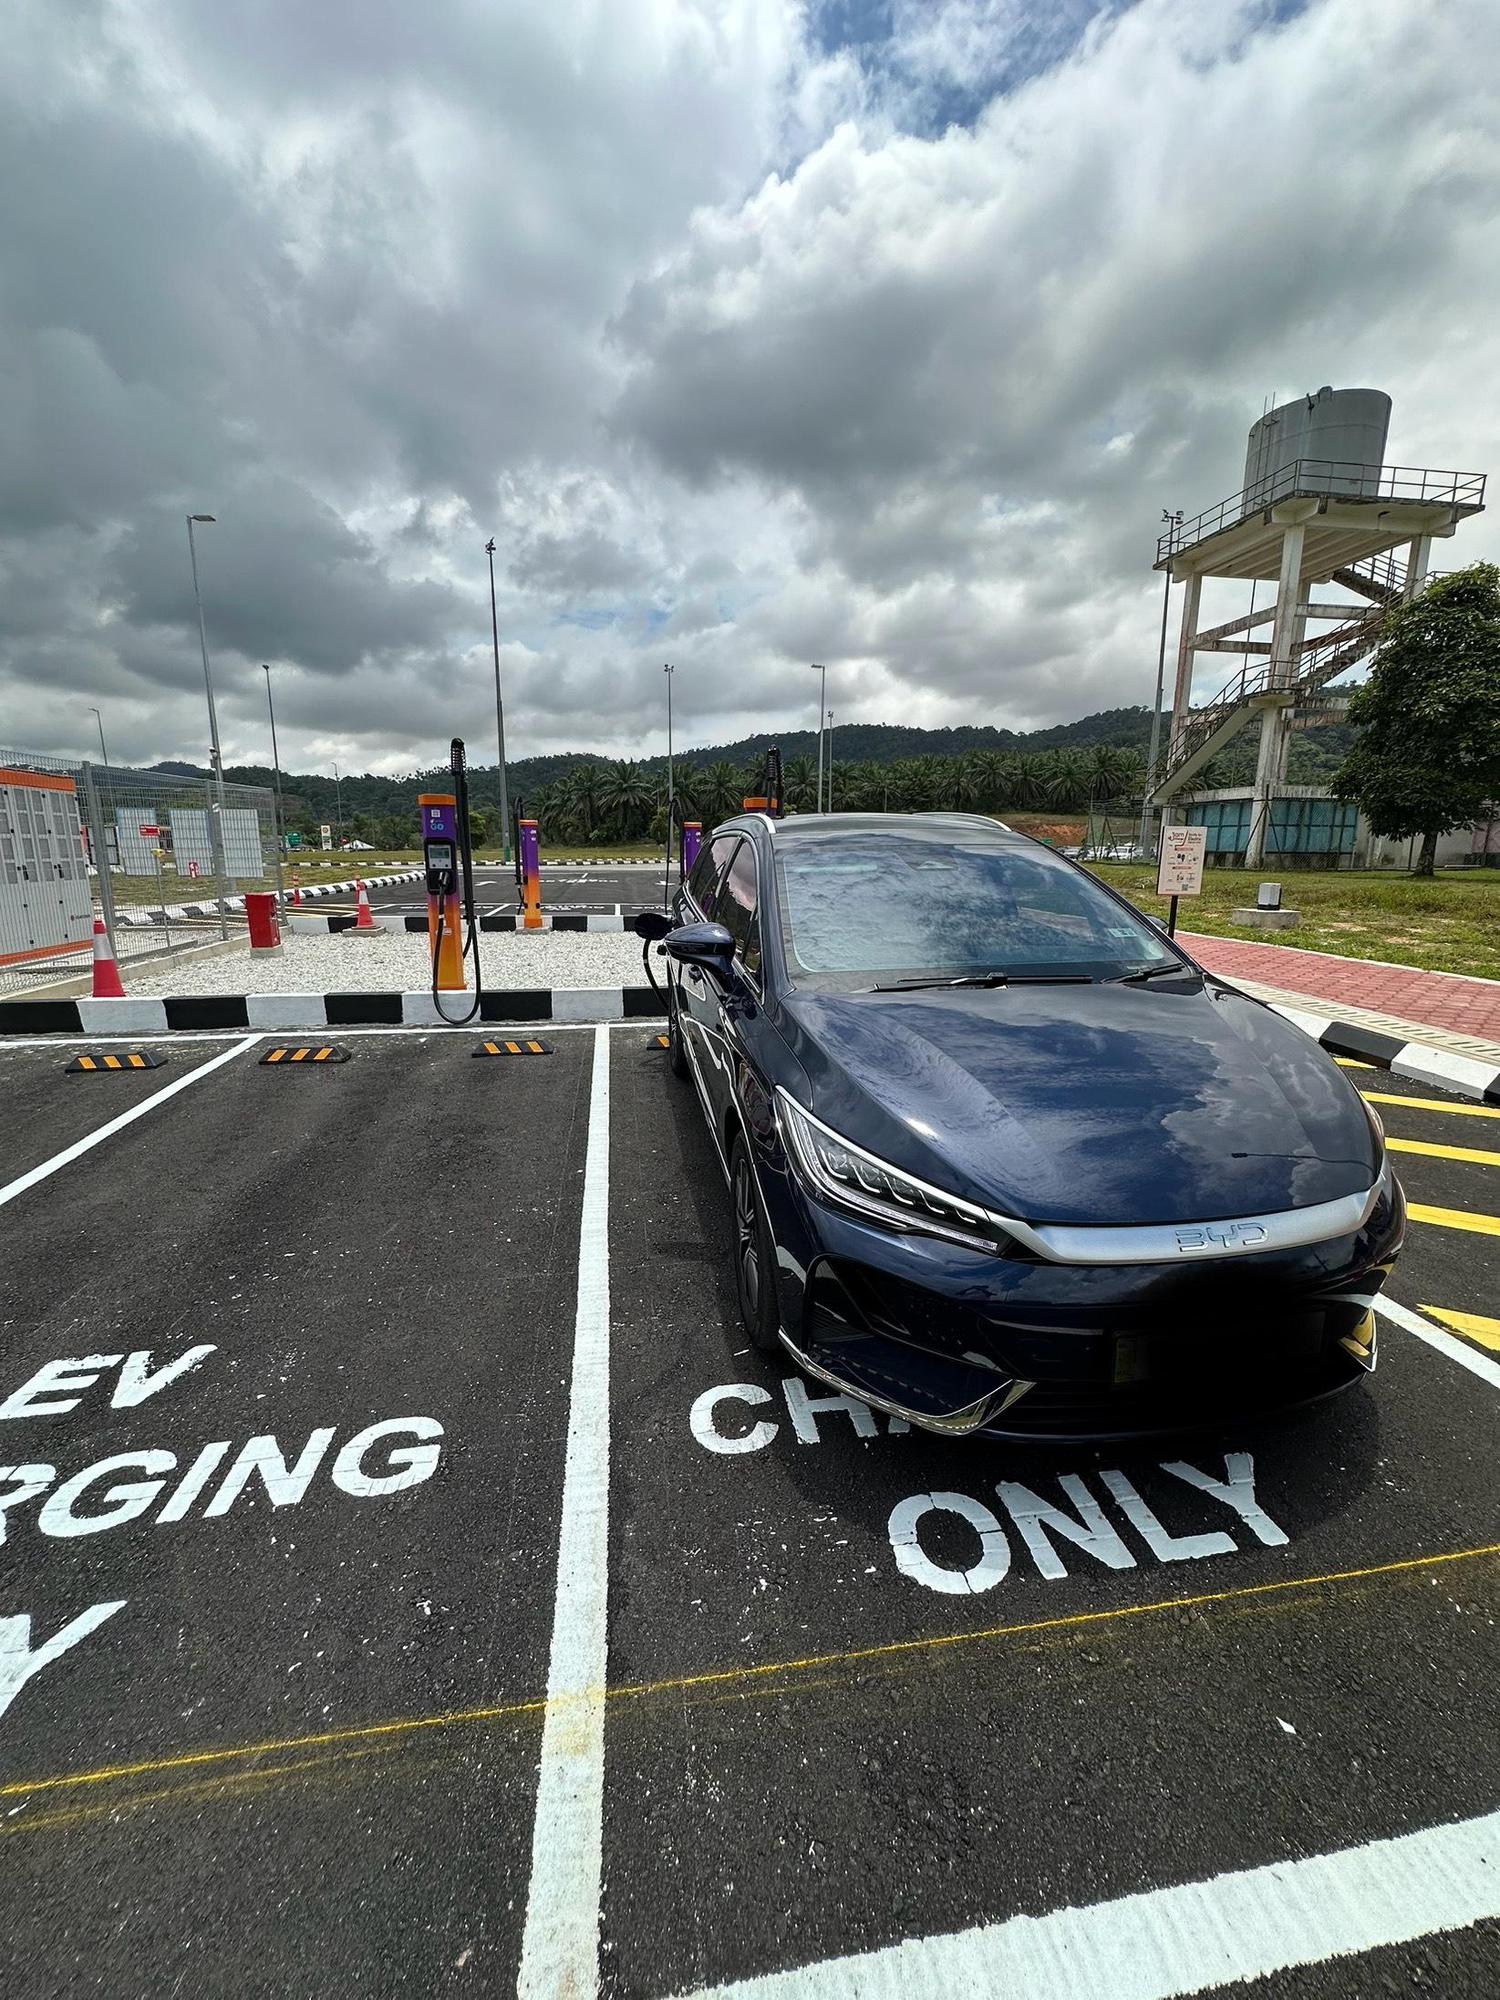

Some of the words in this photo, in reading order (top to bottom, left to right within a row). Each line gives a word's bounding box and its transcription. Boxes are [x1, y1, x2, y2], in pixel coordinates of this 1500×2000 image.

[1175, 1222, 1269, 1252] BYD
[0, 1344, 218, 1419] EV
[689, 1377, 911, 1455] CH
[888, 1452, 1290, 1595] ONLY
